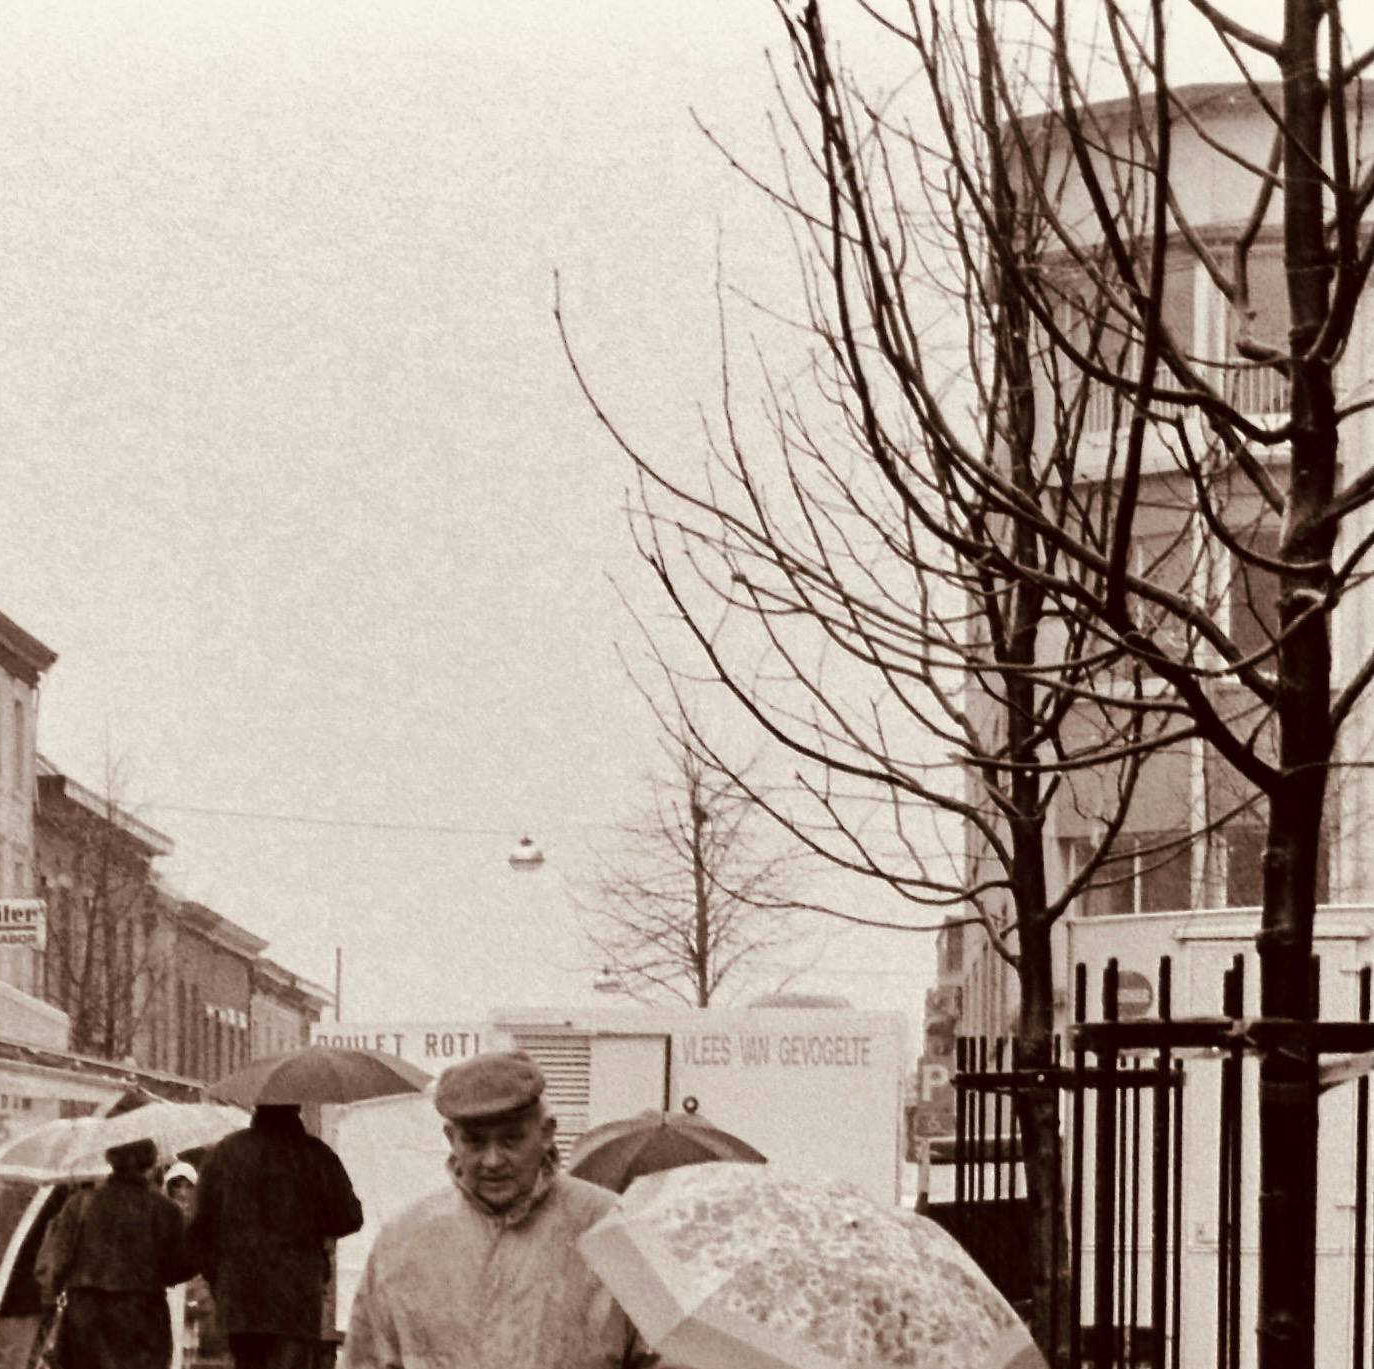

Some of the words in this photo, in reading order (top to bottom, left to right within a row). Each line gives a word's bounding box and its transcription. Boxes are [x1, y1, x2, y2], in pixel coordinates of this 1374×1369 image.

[682, 1035, 732, 1066] VLEES
[738, 1035, 770, 1065] VAN
[778, 1035, 873, 1067] GEVOGELTE
